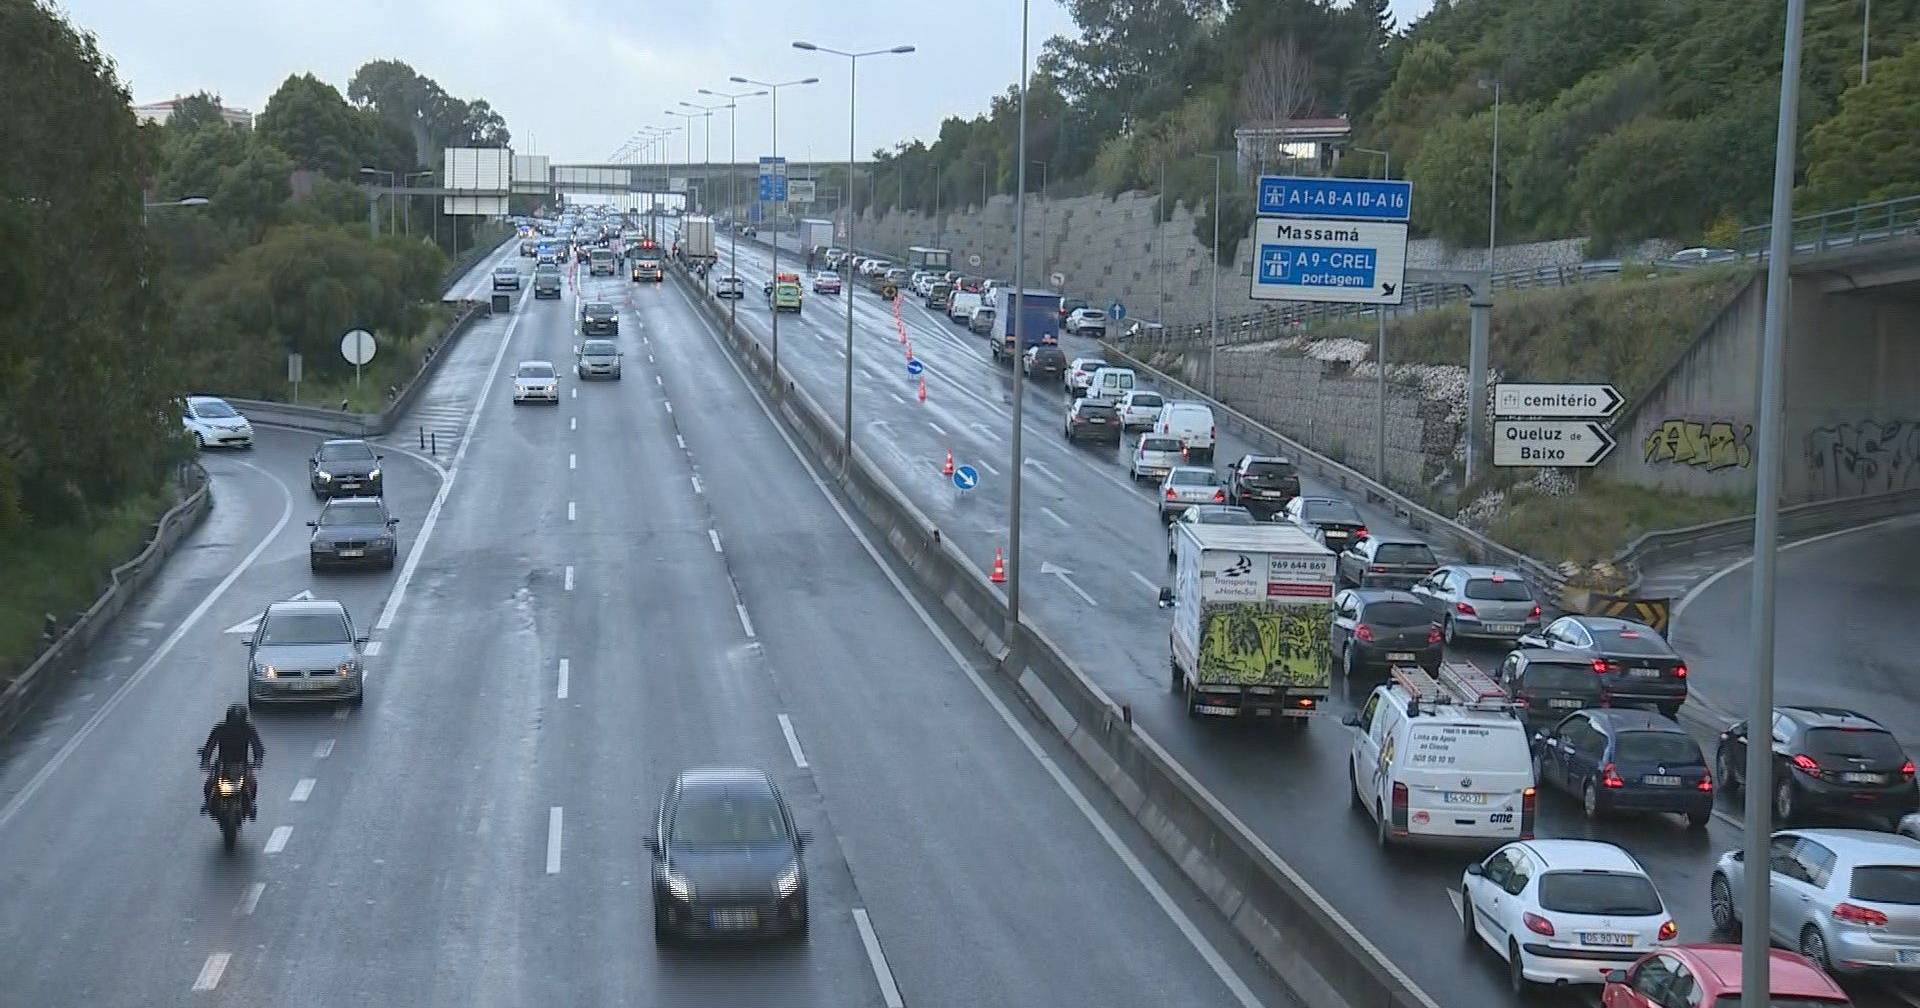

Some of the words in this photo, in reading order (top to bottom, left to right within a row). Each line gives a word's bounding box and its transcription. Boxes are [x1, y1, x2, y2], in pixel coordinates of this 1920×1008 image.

[1277, 225, 1360, 242] Massamá
[1301, 272, 1364, 287] portagem
[1524, 394, 1597, 407] cemitério
[1506, 427, 1562, 441] Queluz
[1570, 432, 1582, 441] de
[1521, 446, 1565, 460] Baixo
[1271, 561, 1288, 569] 969
